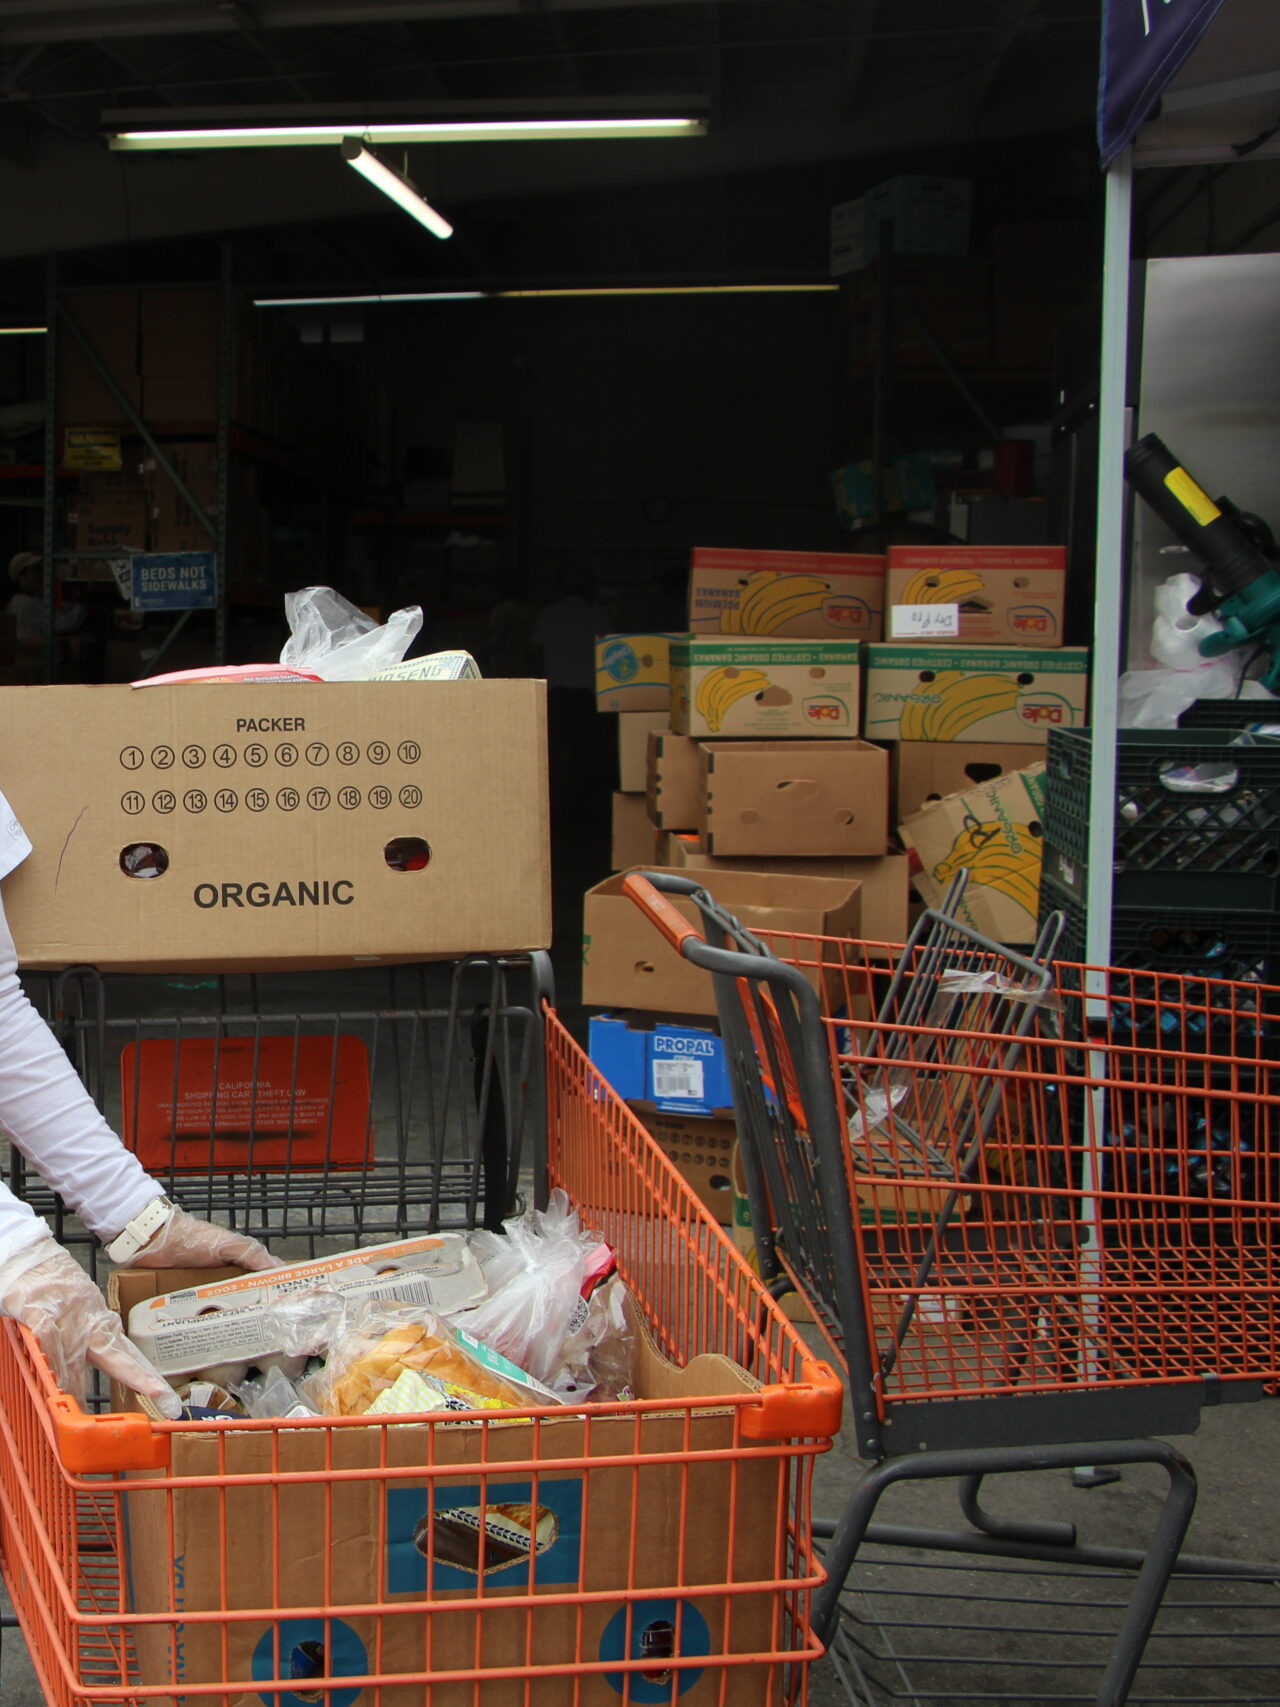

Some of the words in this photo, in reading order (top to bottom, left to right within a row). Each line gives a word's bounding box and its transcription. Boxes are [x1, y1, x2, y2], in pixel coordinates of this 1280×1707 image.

[141, 567, 176, 581] BEDS
[181, 566, 207, 578] NOT
[141, 579, 207, 592] SIDEWALKS
[695, 599, 739, 609] PREMIUM
[1013, 617, 1047, 632] Dole
[694, 654, 732, 663] BANANAS
[735, 653, 770, 663] ORGANIC
[773, 653, 811, 662] CERTIFIED
[874, 657, 910, 666] ORGANIC
[1002, 660, 1039, 669] ORGANIC
[1042, 660, 1083, 670] CERTIFIED
[873, 692, 941, 704] ORGANIC
[808, 707, 840, 720] Dole
[1022, 706, 1062, 723] Dole
[236, 717, 305, 733] PACKER
[985, 789, 1023, 854] ORGANIC
[194, 880, 354, 909] ORGANIC
[655, 1036, 714, 1056] PROPAL
[184, 1091, 230, 1100] SHOPPNG
[231, 1090, 253, 1099] CAR
[258, 1089, 284, 1098] THEFT
[297, 1264, 333, 1276] LARGE
[248, 1273, 292, 1286] BROWN
[271, 1274, 325, 1291] RANGE
[206, 1285, 237, 1296] EGGS
[162, 1314, 220, 1327] COMPLIANT
